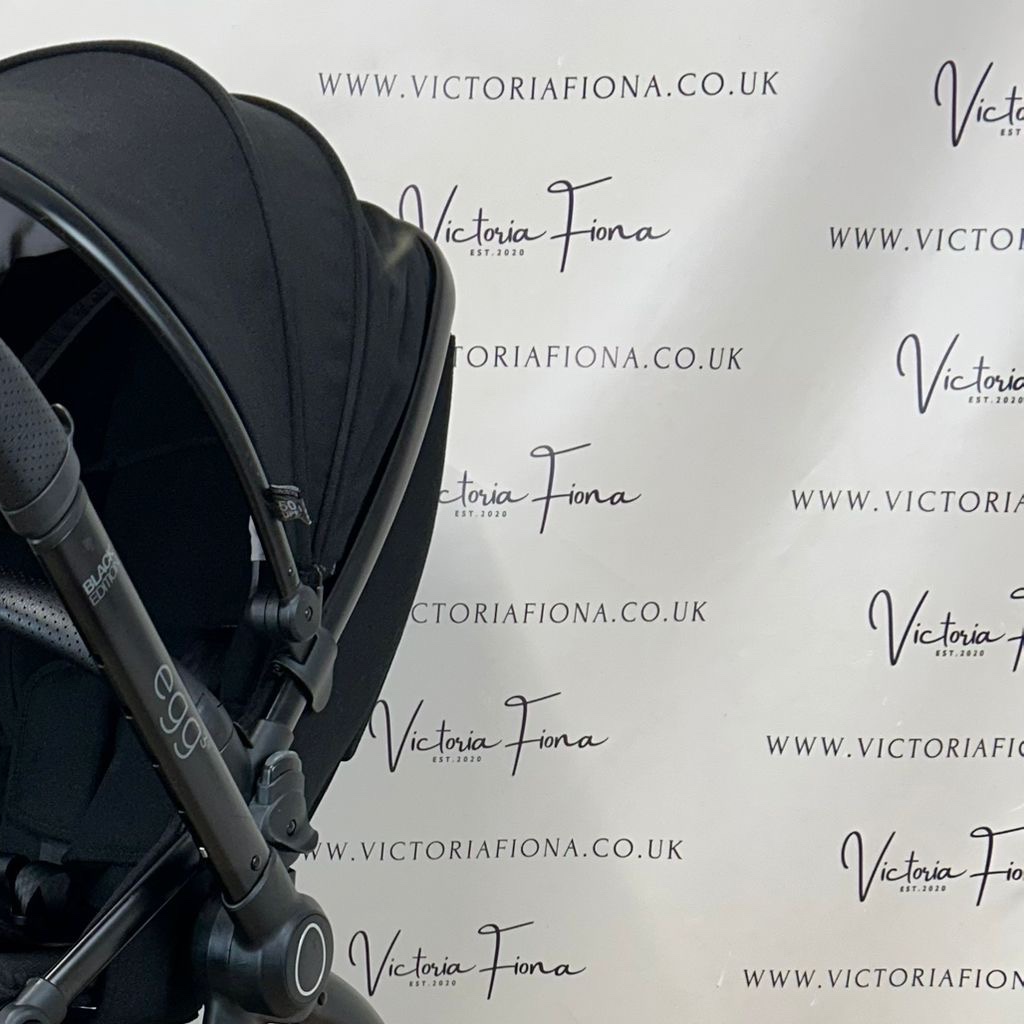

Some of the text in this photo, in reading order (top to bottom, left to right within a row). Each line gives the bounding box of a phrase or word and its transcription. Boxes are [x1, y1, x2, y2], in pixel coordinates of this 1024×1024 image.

[317, 71, 780, 101] WWW.VICTORIAFIONA.CO.UK
[934, 59, 1024, 147] Victo
[1000, 128, 1023, 136] EST
[547, 176, 671, 273] Fiona
[829, 226, 1024, 252] WWW.VICTO
[469, 249, 526, 257] EST.2020
[451, 345, 744, 371] TORIAFIONA.CO.UK
[437, 443, 642, 534] ctoria Fiona
[454, 510, 508, 518] EST.2020
[410, 601, 708, 624] CTORIAFIONA.CO.UK
[868, 589, 1006, 666] Victoria
[369, 692, 609, 776] Victoria Fiona
[766, 735, 1024, 758] WWW.VICTORIAFI
[840, 826, 1024, 907] Victoria Fio
[348, 921, 586, 1000] Victoria Fiona
